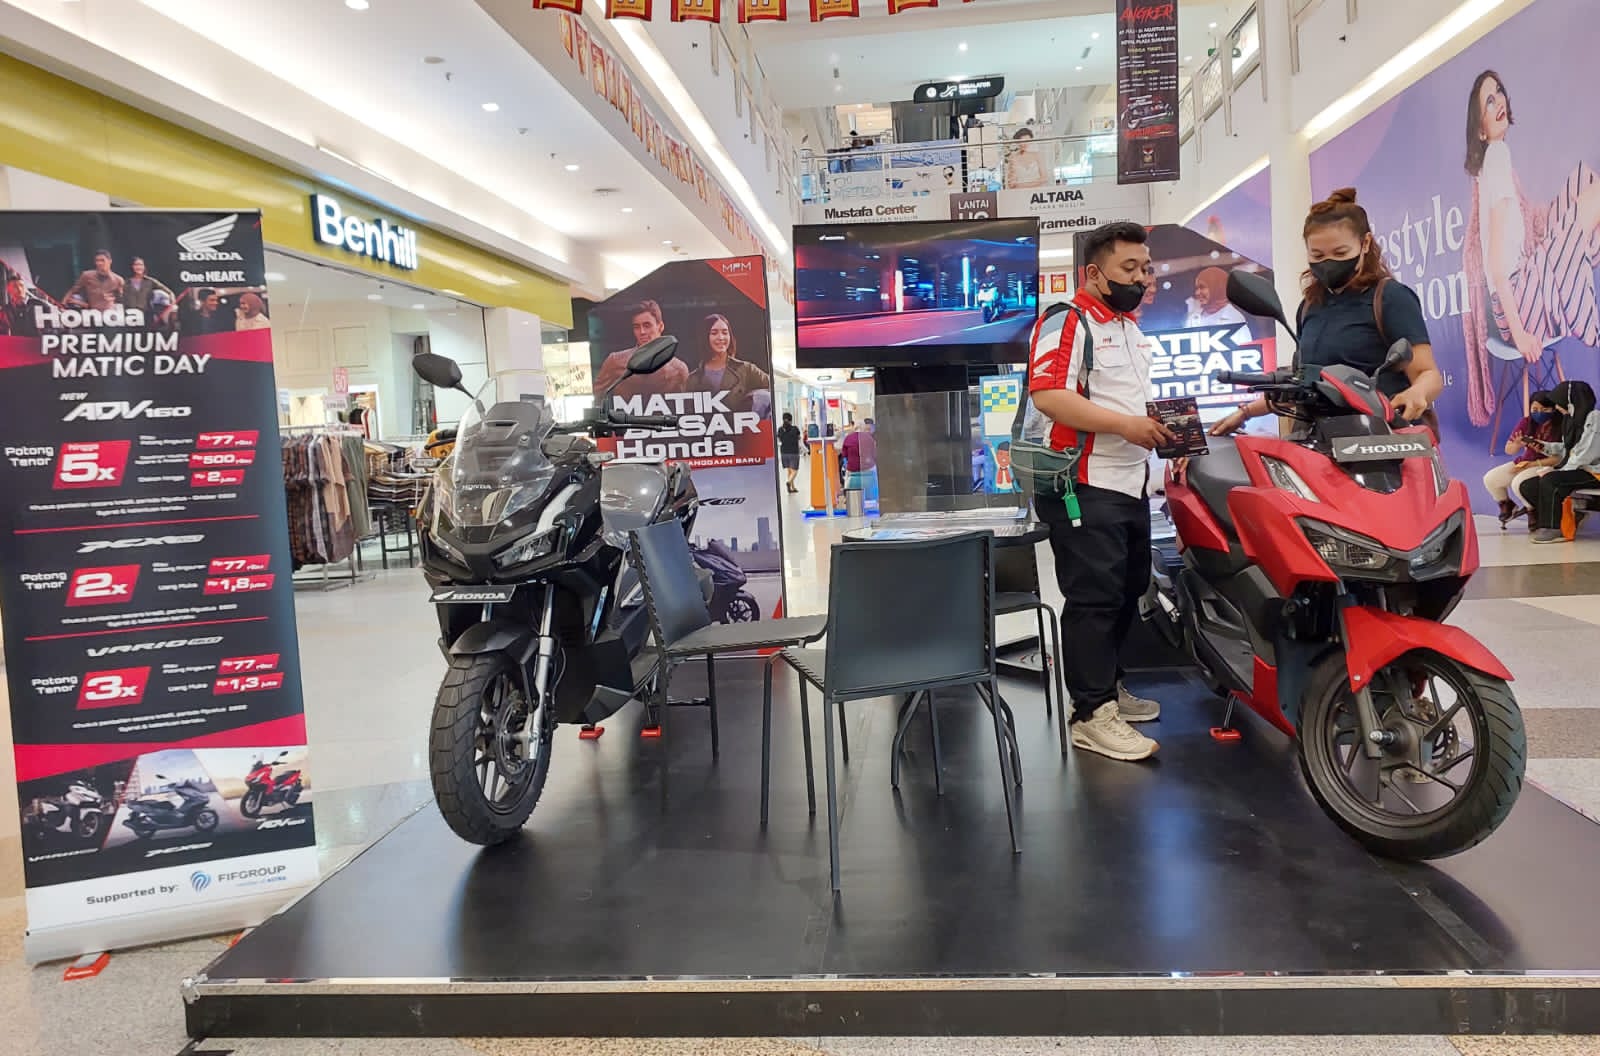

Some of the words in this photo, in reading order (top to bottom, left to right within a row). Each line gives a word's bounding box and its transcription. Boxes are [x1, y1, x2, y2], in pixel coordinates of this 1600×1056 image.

[1030, 190, 1084, 205] ALTARA
[958, 199, 989, 210] LANTAI
[824, 206, 873, 220] Mustafa
[875, 203, 918, 216] Center
[1041, 216, 1097, 229] ramedia
[312, 193, 418, 271] Benhill
[178, 251, 244, 262] HONDA
[33, 303, 146, 329] Honda
[41, 331, 180, 355] PREMIUM
[52, 355, 147, 379] MATIC
[153, 353, 212, 376] DAY
[59, 392, 89, 401] NEW
[613, 390, 732, 418] MATIK
[4, 446, 55, 457] Potong
[616, 437, 735, 460] Honda
[1360, 442, 1426, 454] HONDA
[9, 457, 52, 467] Tenor
[668, 459, 733, 467] KANGGAAN
[20, 571, 68, 583] Potong
[26, 579, 65, 590] Tenor
[451, 592, 507, 600] HONDA
[31, 675, 79, 687] Potong
[35, 684, 77, 695] Tenor
[218, 865, 287, 882] FIFGROUP
[86, 887, 156, 906] Supported
[160, 883, 180, 898] by:
